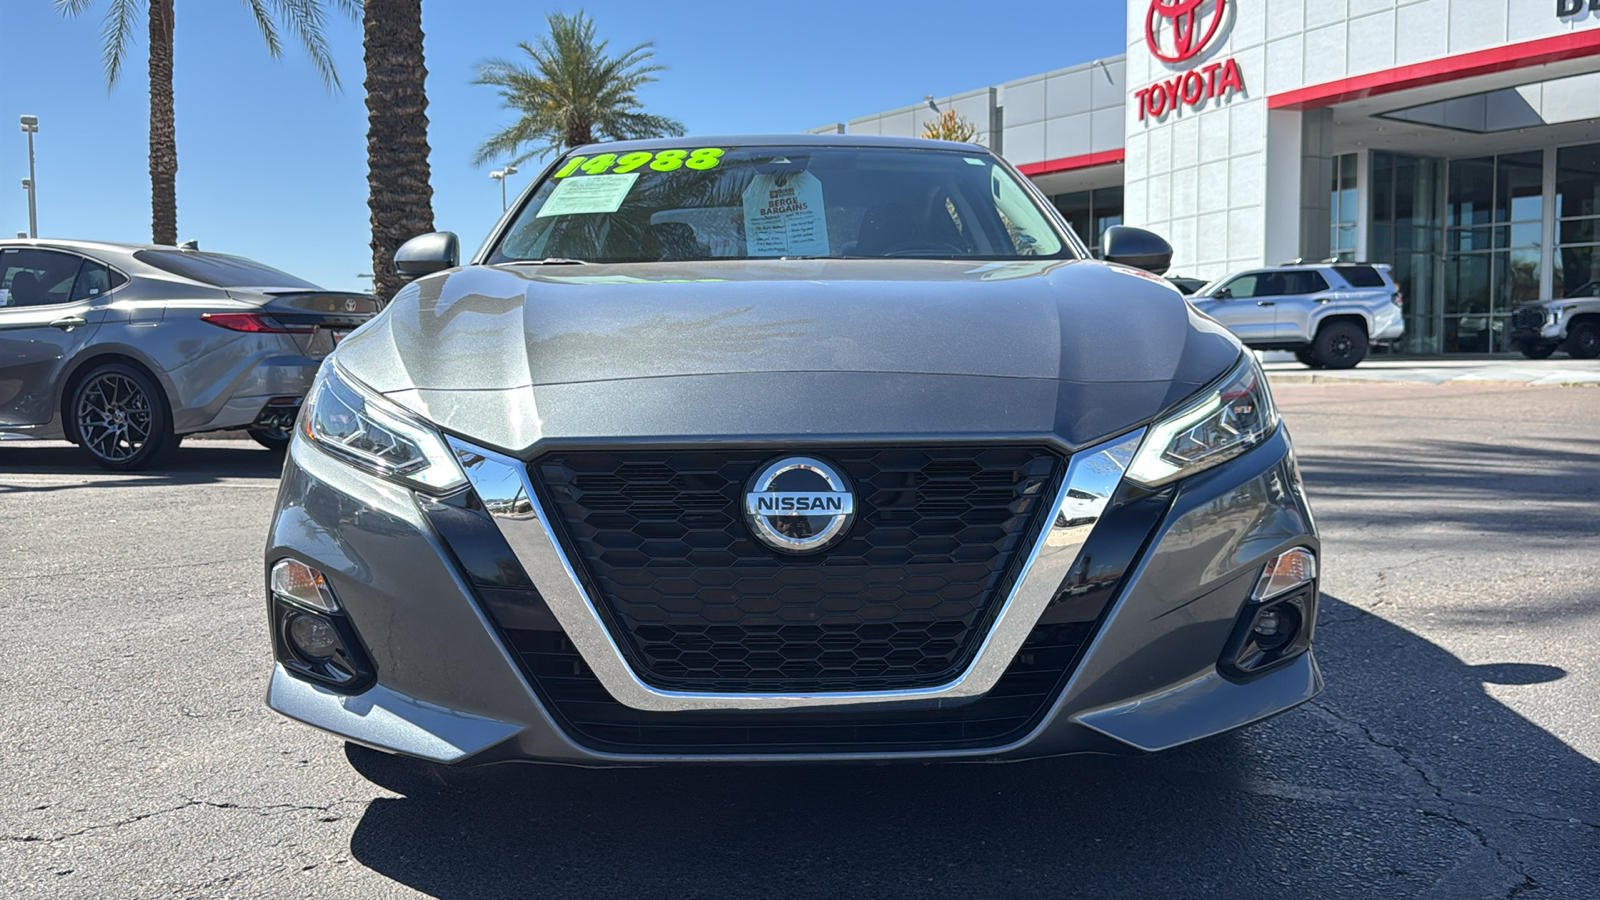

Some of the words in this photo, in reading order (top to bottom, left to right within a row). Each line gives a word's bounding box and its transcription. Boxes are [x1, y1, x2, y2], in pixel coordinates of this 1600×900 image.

[1134, 57, 1243, 122] TOYOTA
[554, 148, 725, 178] 14988
[760, 202, 808, 216] BARGAINS
[768, 197, 799, 208] BERGE
[758, 497, 841, 510] NISSAN
